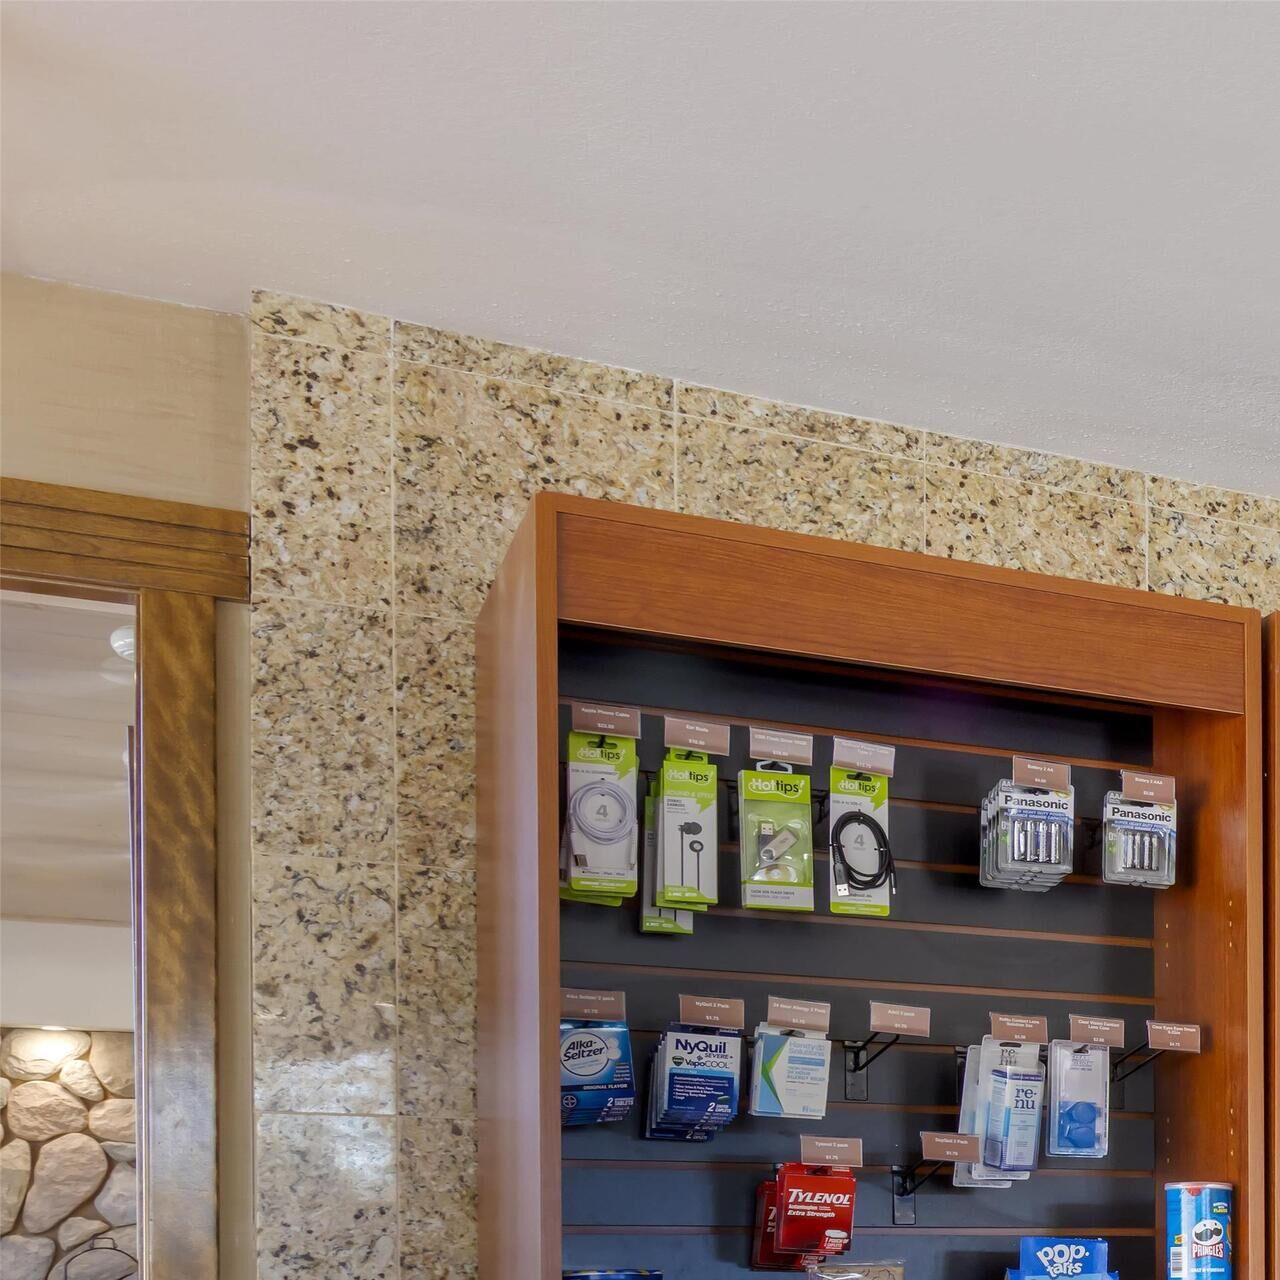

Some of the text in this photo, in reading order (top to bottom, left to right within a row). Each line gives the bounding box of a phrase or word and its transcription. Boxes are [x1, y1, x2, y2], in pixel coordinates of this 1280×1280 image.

[1004, 795, 1069, 810] Panasonic
[595, 804, 609, 818] 4
[1111, 806, 1172, 823] Panasonic
[567, 1038, 597, 1052] Alka-
[675, 1038, 727, 1055] NyQuil
[562, 1047, 606, 1063] Seltzer
[684, 1059, 730, 1069] VapoCOOL
[606, 1097, 614, 1107] 2
[707, 1102, 716, 1112] 2
[787, 1188, 853, 1206] TYLENOL
[787, 1209, 836, 1219] Extra Strength
[1191, 1242, 1225, 1260] PRINGLES
